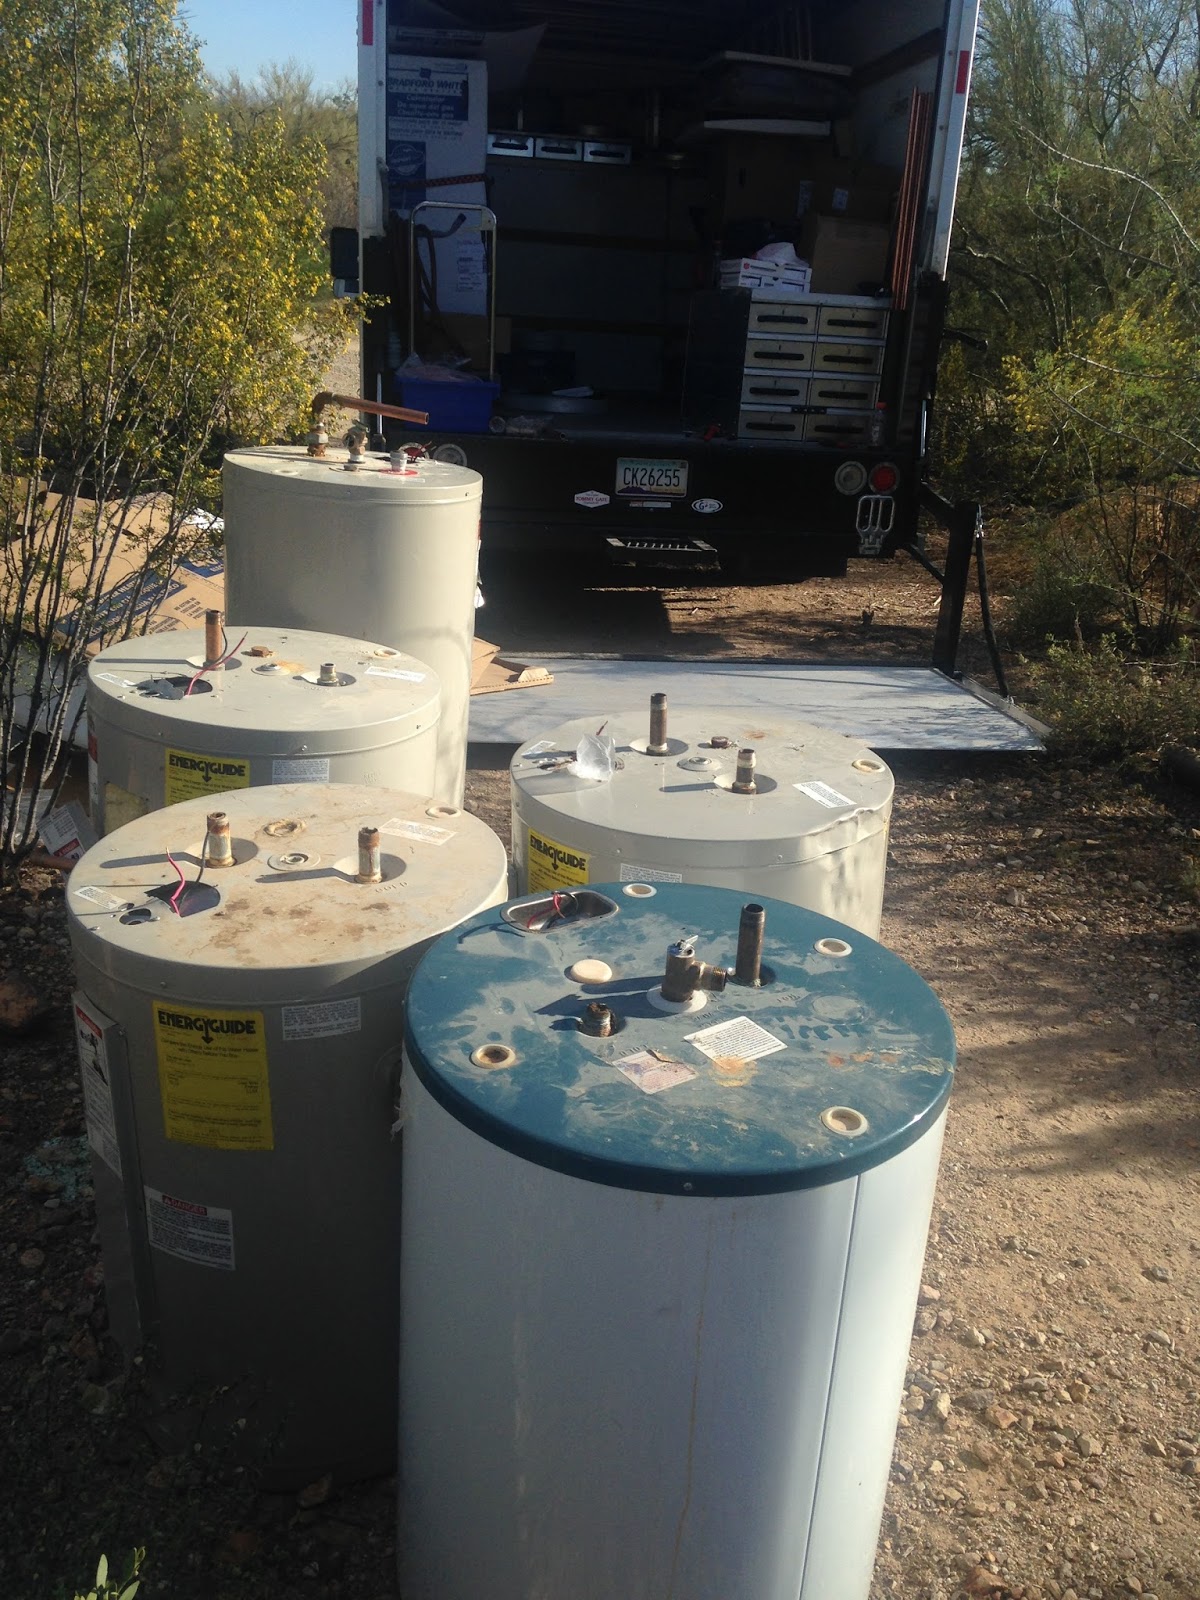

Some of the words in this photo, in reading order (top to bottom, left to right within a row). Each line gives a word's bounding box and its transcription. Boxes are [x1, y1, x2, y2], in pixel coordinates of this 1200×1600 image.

[624, 467, 681, 487] CK26255
[169, 754, 246, 777] ENERGYGUIDE
[530, 835, 587, 871] ENERGYGUIDE
[158, 1011, 256, 1035] ENERGYGUIDE
[173, 1200, 206, 1214] DANGER
